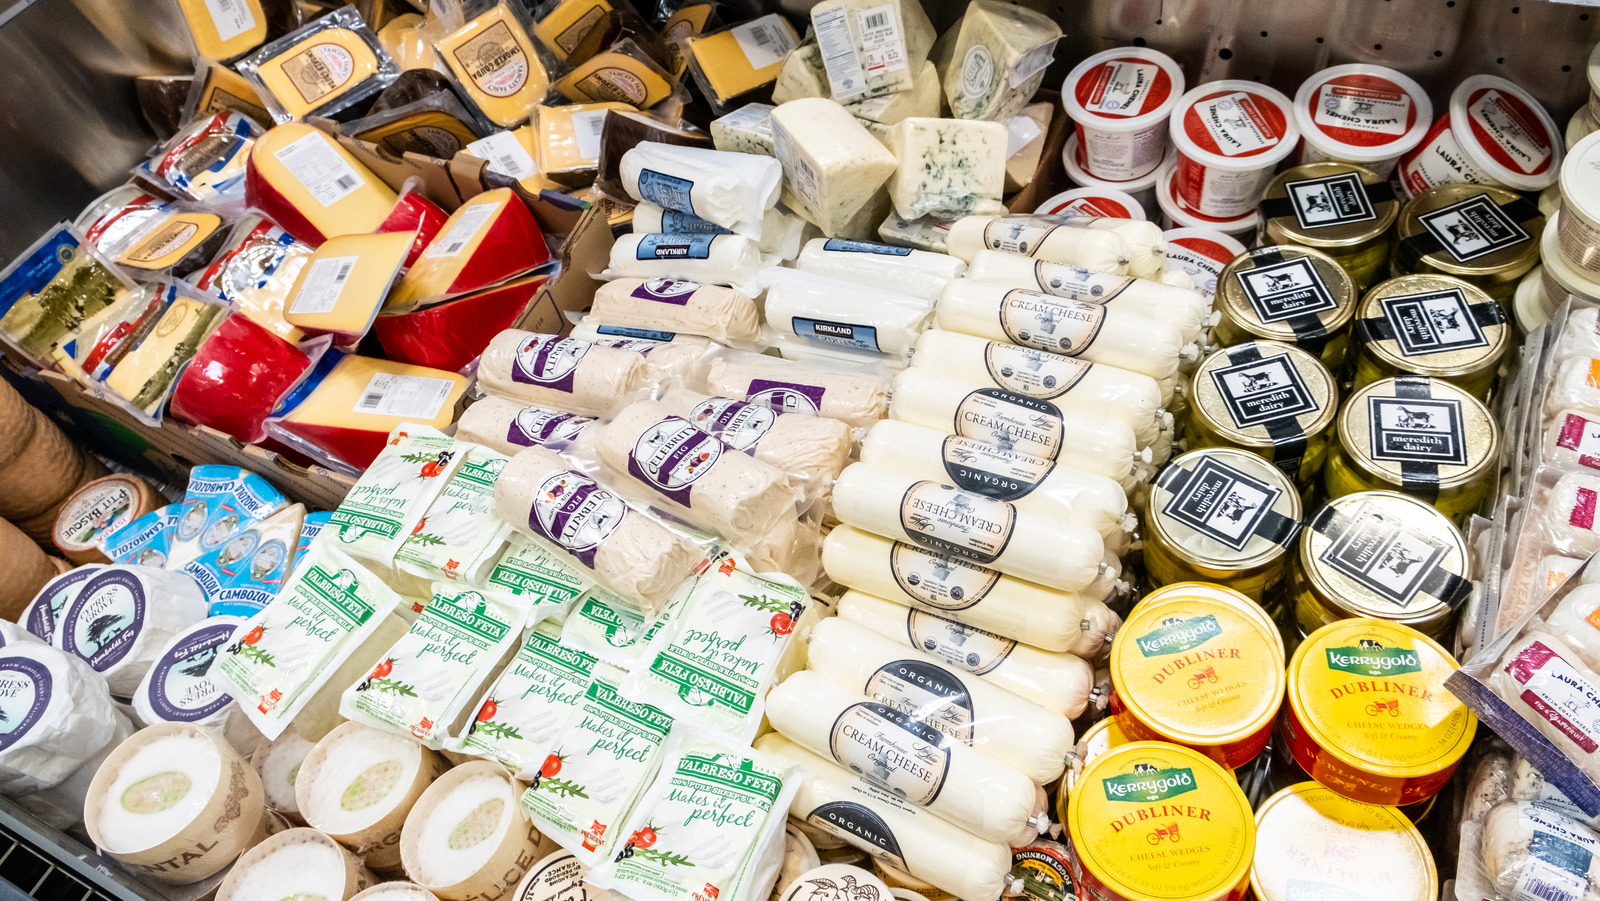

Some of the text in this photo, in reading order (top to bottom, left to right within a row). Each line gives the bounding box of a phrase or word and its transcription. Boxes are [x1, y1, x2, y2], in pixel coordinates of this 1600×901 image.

[304, 49, 336, 90] SMOKED GOUDA
[472, 45, 521, 80] SMOKED GOUDA
[592, 73, 617, 93] SMOKED
[1120, 68, 1145, 110] LAURA CHENEL
[1207, 104, 1242, 148] LAURA CHENEL
[1325, 109, 1398, 126] LAURA CHENEL
[1480, 108, 1506, 140] CHENEL
[1435, 144, 1462, 173] LAURA
[1484, 213, 1503, 229] dairy
[655, 247, 689, 256] KIRKLAND
[1166, 253, 1196, 265] LAURA
[1269, 290, 1312, 308] meredith
[1281, 298, 1307, 310] dairy
[1010, 300, 1094, 323] CREAM CHEESE
[1034, 313, 1062, 325] Original
[815, 323, 852, 335] KIRKLAND
[1402, 315, 1418, 336] dairy
[1408, 307, 1431, 342] meredith
[544, 341, 555, 352] FIG
[991, 390, 1048, 411] ORGANIC
[1246, 390, 1291, 409] meredith
[1258, 399, 1285, 413] dairy
[720, 412, 733, 424] FIG
[964, 411, 1051, 447] CREAM CHEESE
[992, 411, 1027, 427] Farmhouse
[991, 430, 1019, 444] Original
[1392, 434, 1442, 445] meredith
[1402, 441, 1432, 453] dairy
[649, 426, 696, 475] CELEBRITY
[674, 445, 689, 460] FIG
[188, 479, 236, 493] CAMBOZOLA
[959, 469, 1018, 490] ORGANIC
[567, 495, 583, 511] FIG
[1194, 479, 1224, 514] meredith
[62, 508, 103, 541] BASQUE
[349, 516, 397, 533] VALBRESO
[912, 498, 1002, 535] CREAM CHEESE
[937, 516, 971, 534] Farmhouse
[111, 521, 166, 558] CAMBOZOLA
[921, 536, 979, 559] ORGANIC
[928, 558, 955, 572] Original
[98, 577, 121, 586] HUMBOLDT
[183, 561, 221, 598] CAMBOZOLA
[498, 570, 520, 584] FETA
[80, 586, 118, 620] CYPRESS
[219, 589, 276, 607] CAMBOZOLA
[307, 570, 366, 618] VALBRESO FETA
[39, 603, 50, 633] Humboldt
[85, 598, 116, 623] GROVE
[429, 598, 502, 637] ALBRESO FETA
[590, 605, 614, 620] FETA
[285, 615, 339, 642] perfect
[410, 622, 457, 646] Makes it
[944, 623, 972, 638] Original
[91, 630, 135, 667] Humboldt Fog
[174, 630, 230, 659] Humboldt Fog
[529, 636, 581, 665] VALBRESO
[683, 630, 747, 653] perfect
[416, 642, 478, 665] perfect
[707, 649, 765, 675] Makes it
[509, 664, 562, 687] Makes it
[1152, 648, 1241, 685] DUBLINER
[660, 660, 749, 707] VALBRESO FETA
[899, 666, 958, 697] ORGANIC
[1329, 681, 1433, 702] DUBLINER
[1551, 670, 1583, 692] LAURA
[521, 682, 583, 706] perfect
[596, 685, 650, 717] VALBRESO
[1534, 701, 1545, 710] FIG
[575, 716, 630, 741] Makes it
[877, 707, 936, 741] ORGANIC
[1388, 722, 1430, 730] WEDGES
[1408, 710, 1462, 760] WEDGES 14 OZ (400g)
[873, 730, 908, 755] Farmhouse
[1390, 732, 1418, 742] Creamy
[587, 737, 651, 762] perfect
[842, 723, 933, 783] CREAM CHEESE
[867, 752, 896, 773] Original
[1305, 748, 1392, 793] DUBLINER
[680, 760, 776, 794] VALBRESO FETA
[663, 789, 727, 809] Makes it
[683, 803, 755, 827] perfect
[1109, 805, 1212, 833] DUBLINER
[829, 812, 886, 846] ORGANIC
[1529, 816, 1595, 844] AURA CHENEL
[1130, 846, 1211, 862] CHEESE WEDGES
[1148, 862, 1161, 872] Soft
[1173, 859, 1200, 869] Creamy
[1016, 852, 1072, 885] MORNING FOGGY
[1152, 883, 1163, 891] OZ
[1191, 870, 1219, 889] WEDGES
